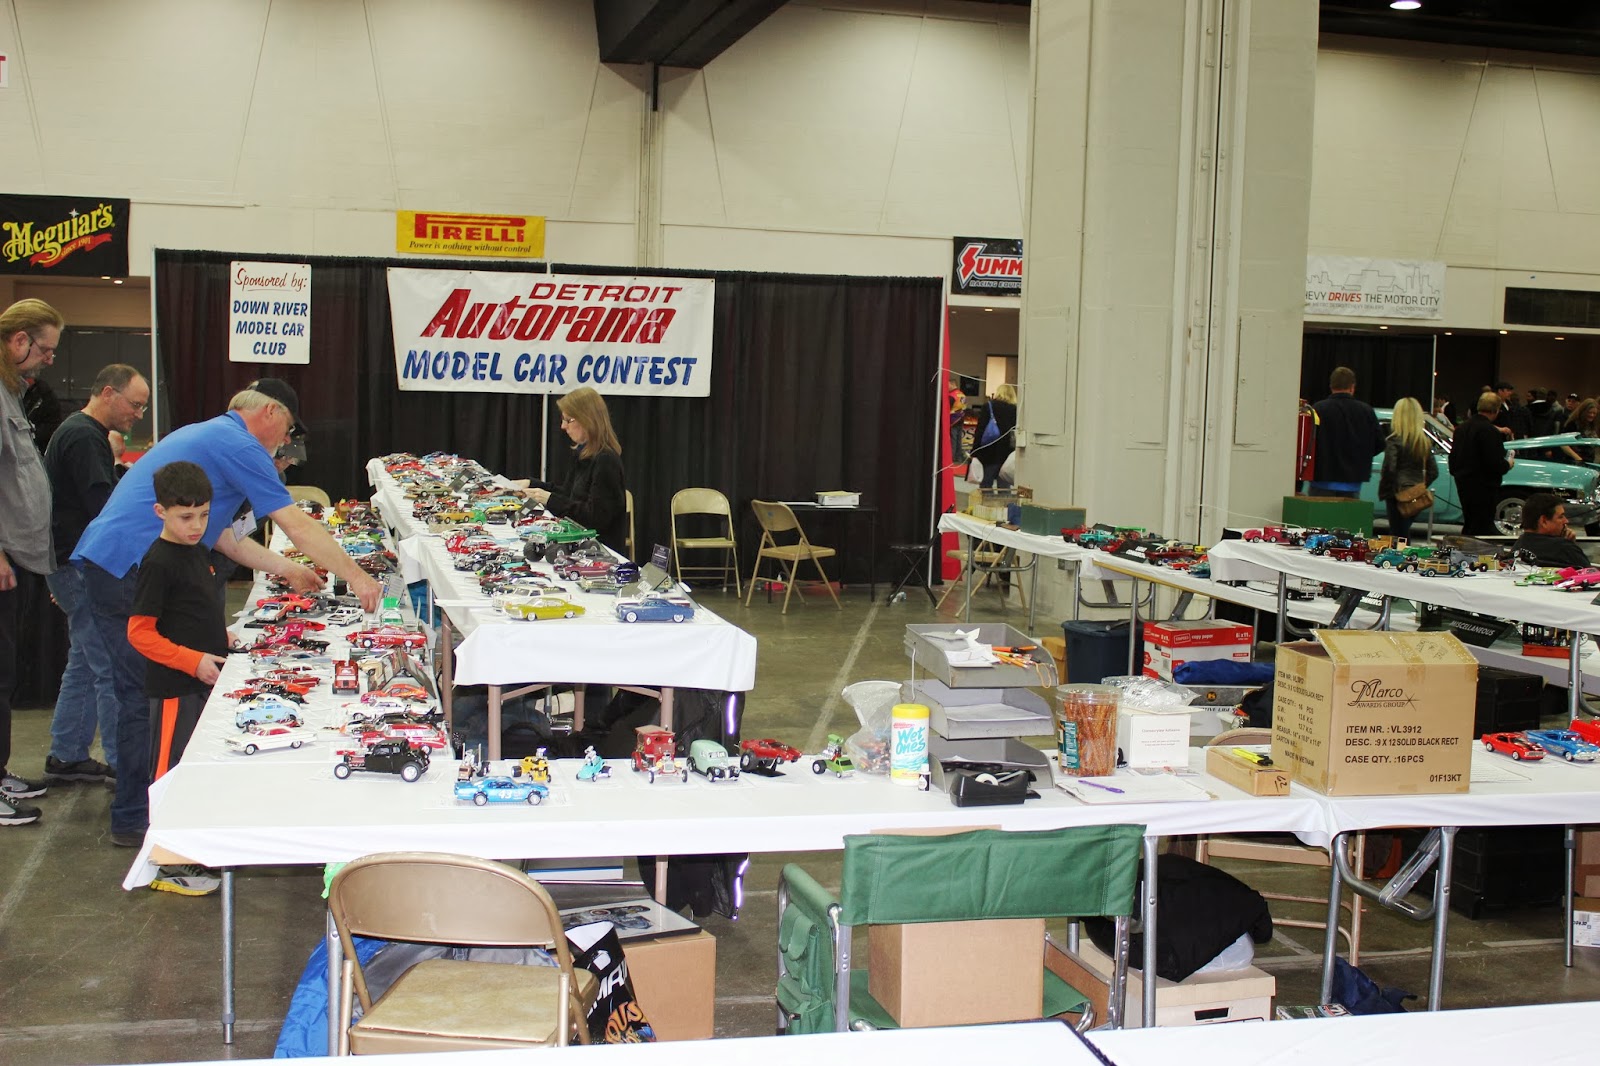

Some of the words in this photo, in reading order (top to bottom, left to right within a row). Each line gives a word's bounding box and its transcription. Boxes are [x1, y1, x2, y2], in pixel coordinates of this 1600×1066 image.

[2, 203, 114, 263] Meguiar's
[414, 213, 527, 243] PIRELLI
[61, 244, 77, 256] since
[78, 237, 91, 248] 1901
[409, 241, 433, 249] Power
[434, 241, 442, 250] is
[442, 243, 473, 252] nothing
[474, 244, 503, 253] without
[504, 245, 532, 253] control
[234, 267, 288, 292] Sponsored
[290, 272, 308, 293] by:
[968, 280, 998, 288] RACING
[528, 282, 683, 304] DETROIT
[1328, 292, 1362, 303] DRIVES
[1365, 293, 1383, 304] THE
[1384, 294, 1418, 305] MOTOR
[1420, 296, 1440, 306] CITY
[233, 300, 270, 315] DOWN
[273, 302, 309, 317] RIVER
[420, 288, 677, 344] Autorama
[235, 320, 278, 336] MODEL
[281, 322, 305, 337] CAR
[253, 341, 287, 356] CLUB
[402, 350, 503, 381] MODEL
[513, 353, 568, 386] CAR
[576, 354, 698, 386] CONTEST
[1450, 620, 1495, 635] MISCELLANEOUS
[1347, 679, 1403, 706] Marco
[898, 726, 926, 743] Wet
[1345, 738, 1372, 746] DESC.
[1417, 738, 1440, 746] BLACK
[1441, 737, 1459, 745] RECT
[896, 738, 926, 755] Ones
[1345, 755, 1369, 763] CASE
[1371, 755, 1392, 763] QTY.
[1429, 774, 1462, 782] 01F13KT
